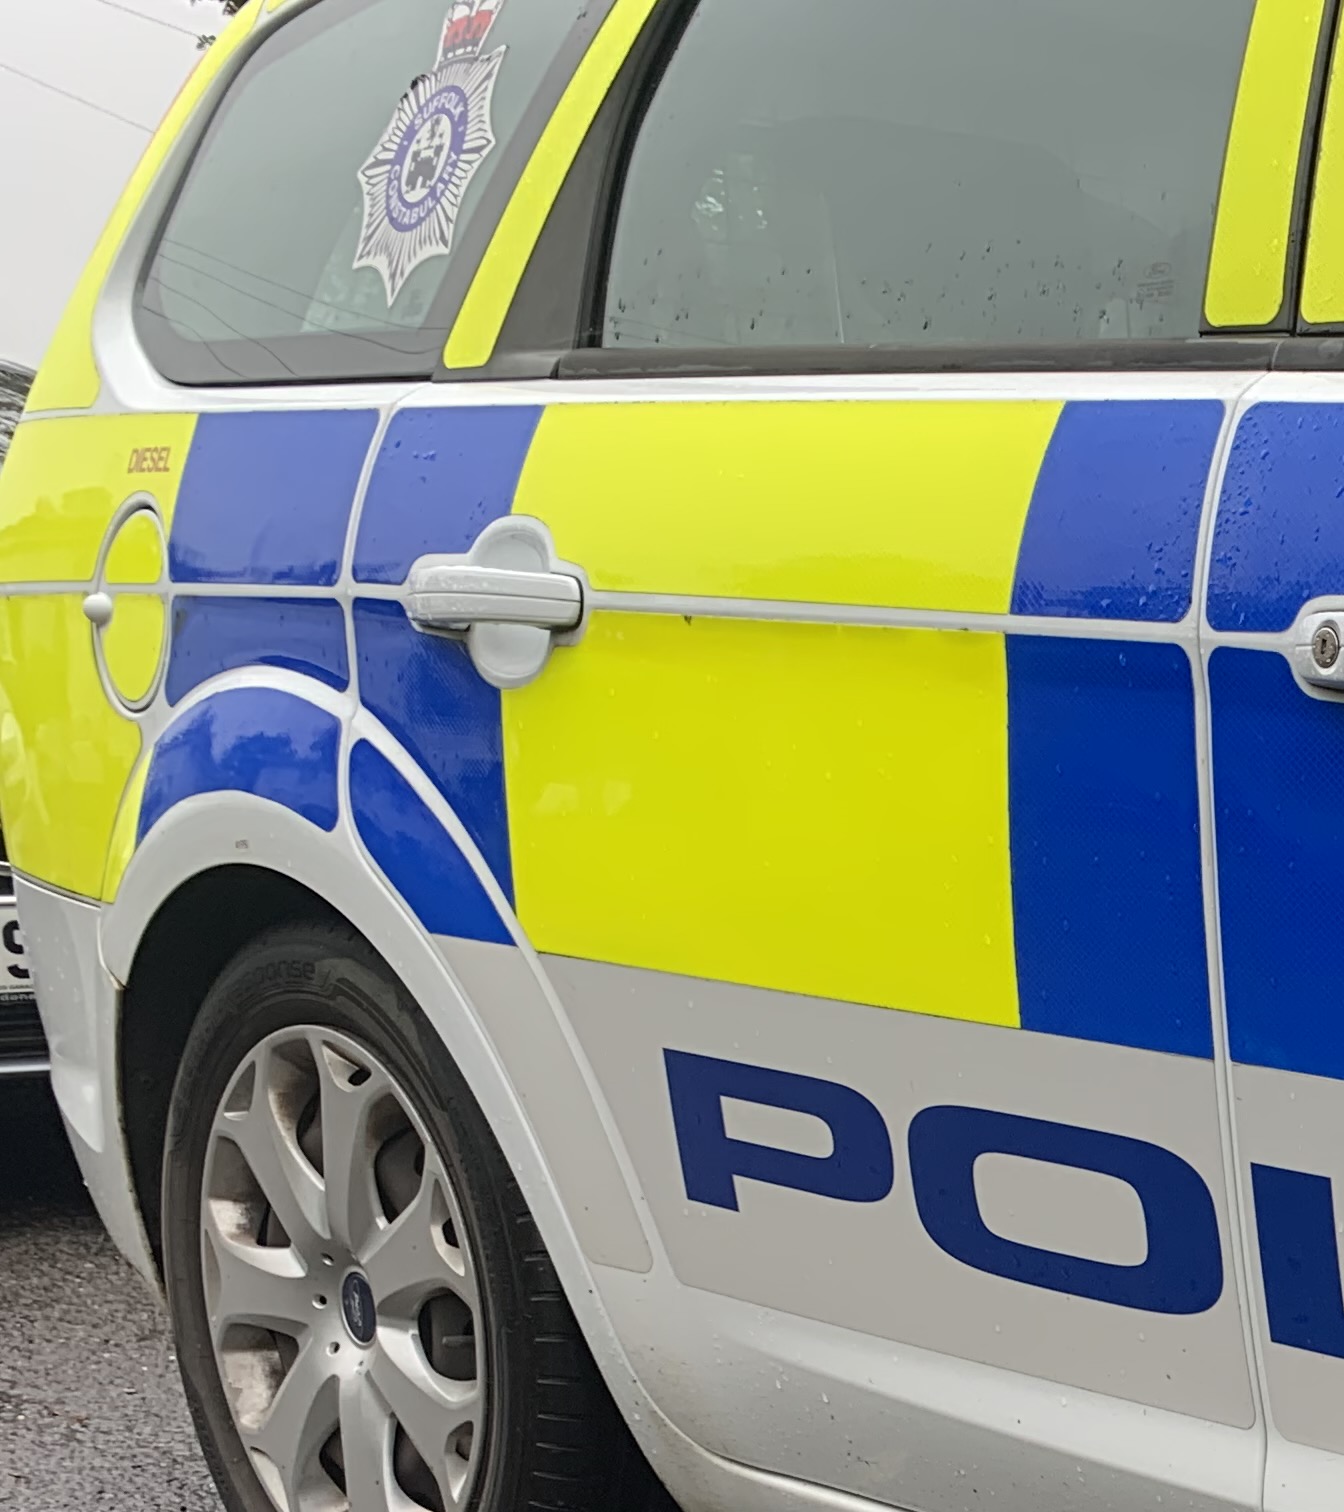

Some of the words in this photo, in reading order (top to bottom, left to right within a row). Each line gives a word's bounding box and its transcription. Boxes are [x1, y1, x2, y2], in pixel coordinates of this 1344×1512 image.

[414, 92, 465, 130] SUFFOLK
[388, 151, 458, 225] CONSTABULARY
[127, 446, 171, 473] DIESEL
